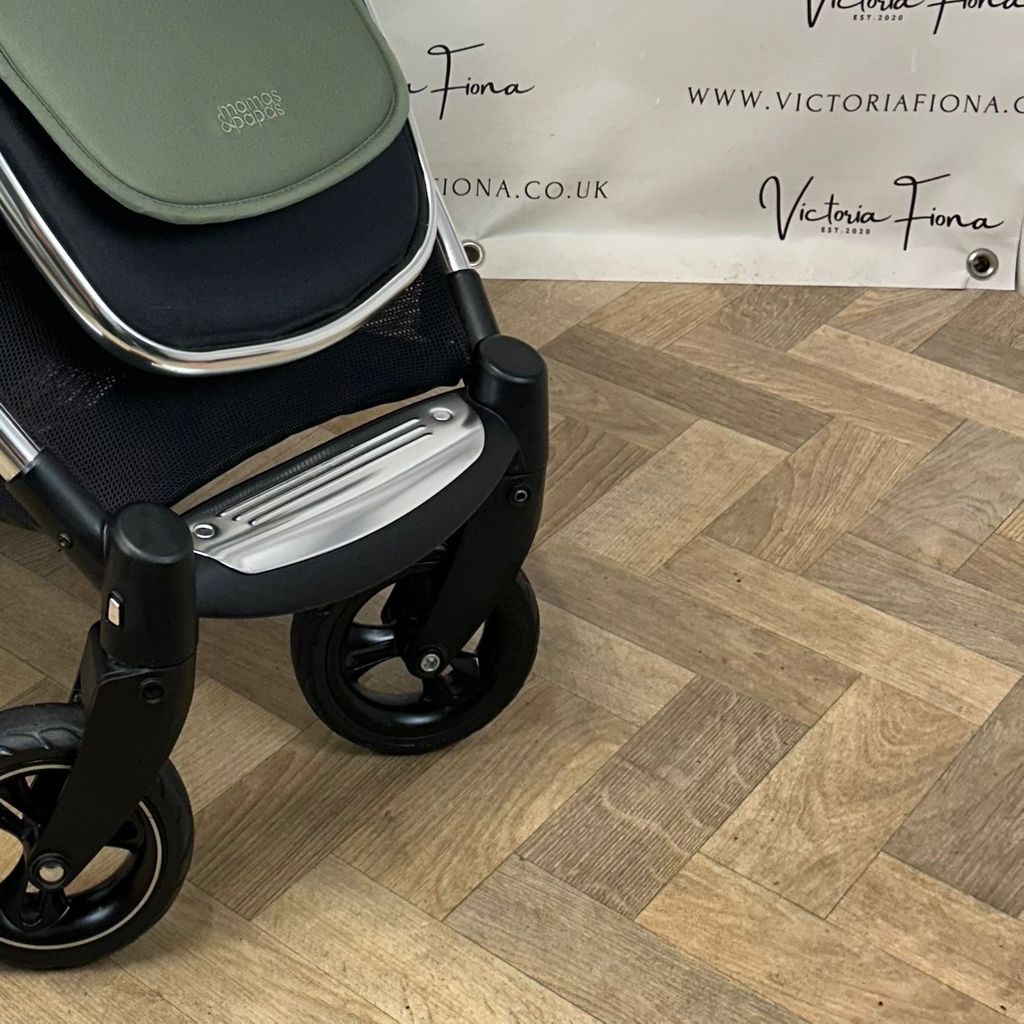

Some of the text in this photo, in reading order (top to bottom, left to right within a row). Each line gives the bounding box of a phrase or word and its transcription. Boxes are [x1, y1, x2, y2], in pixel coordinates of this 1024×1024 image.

[852, 13, 904, 22] EST.2020
[426, 42, 536, 121] Fiona
[218, 90, 282, 120] mamas
[758, 172, 1006, 254] Victoria Fiona
[820, 225, 871, 236] EST.2020
